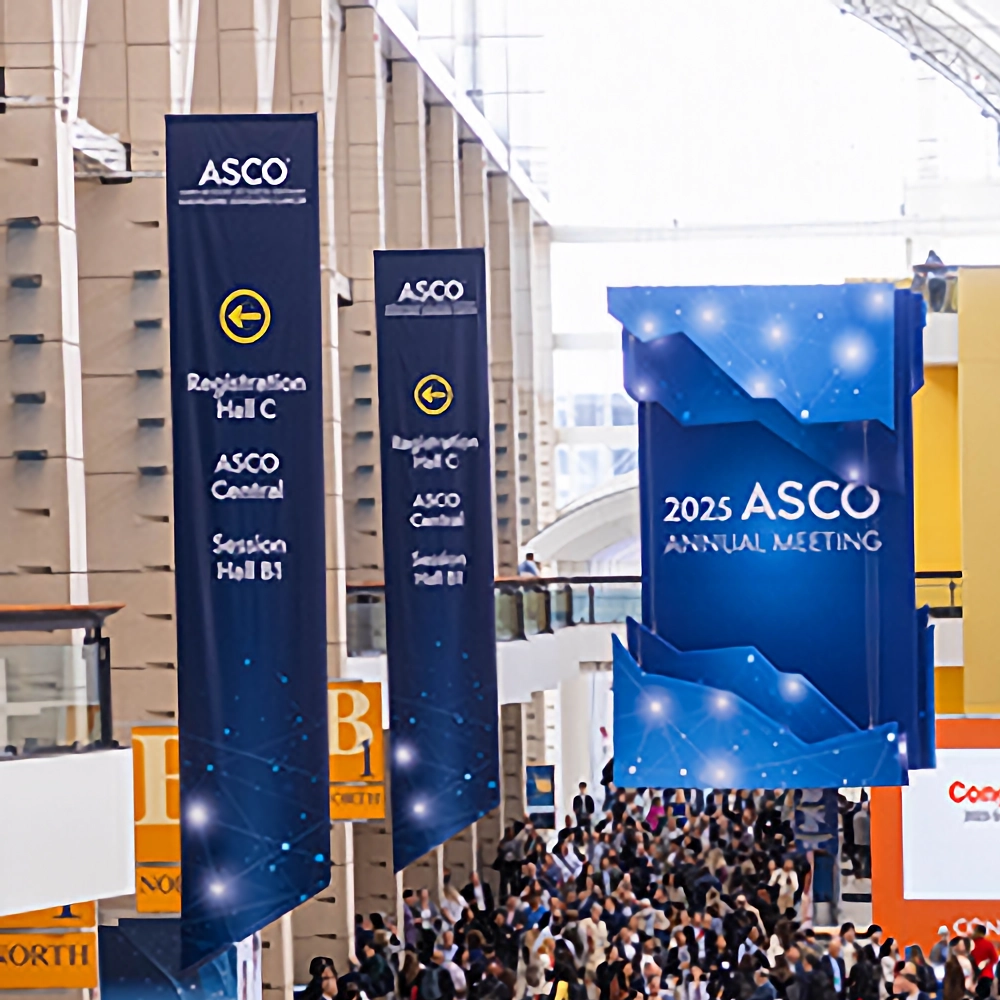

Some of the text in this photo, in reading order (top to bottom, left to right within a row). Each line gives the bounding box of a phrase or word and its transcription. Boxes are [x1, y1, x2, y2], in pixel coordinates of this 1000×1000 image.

[198, 157, 288, 186] ASCO
[216, 398, 277, 419] Hall C
[214, 453, 280, 474] ASCO
[412, 493, 461, 508] ASCO
[663, 480, 881, 522] 2025 ASCO
[663, 530, 883, 554] ANNUAL MEETING
[216, 560, 255, 581] Hall
